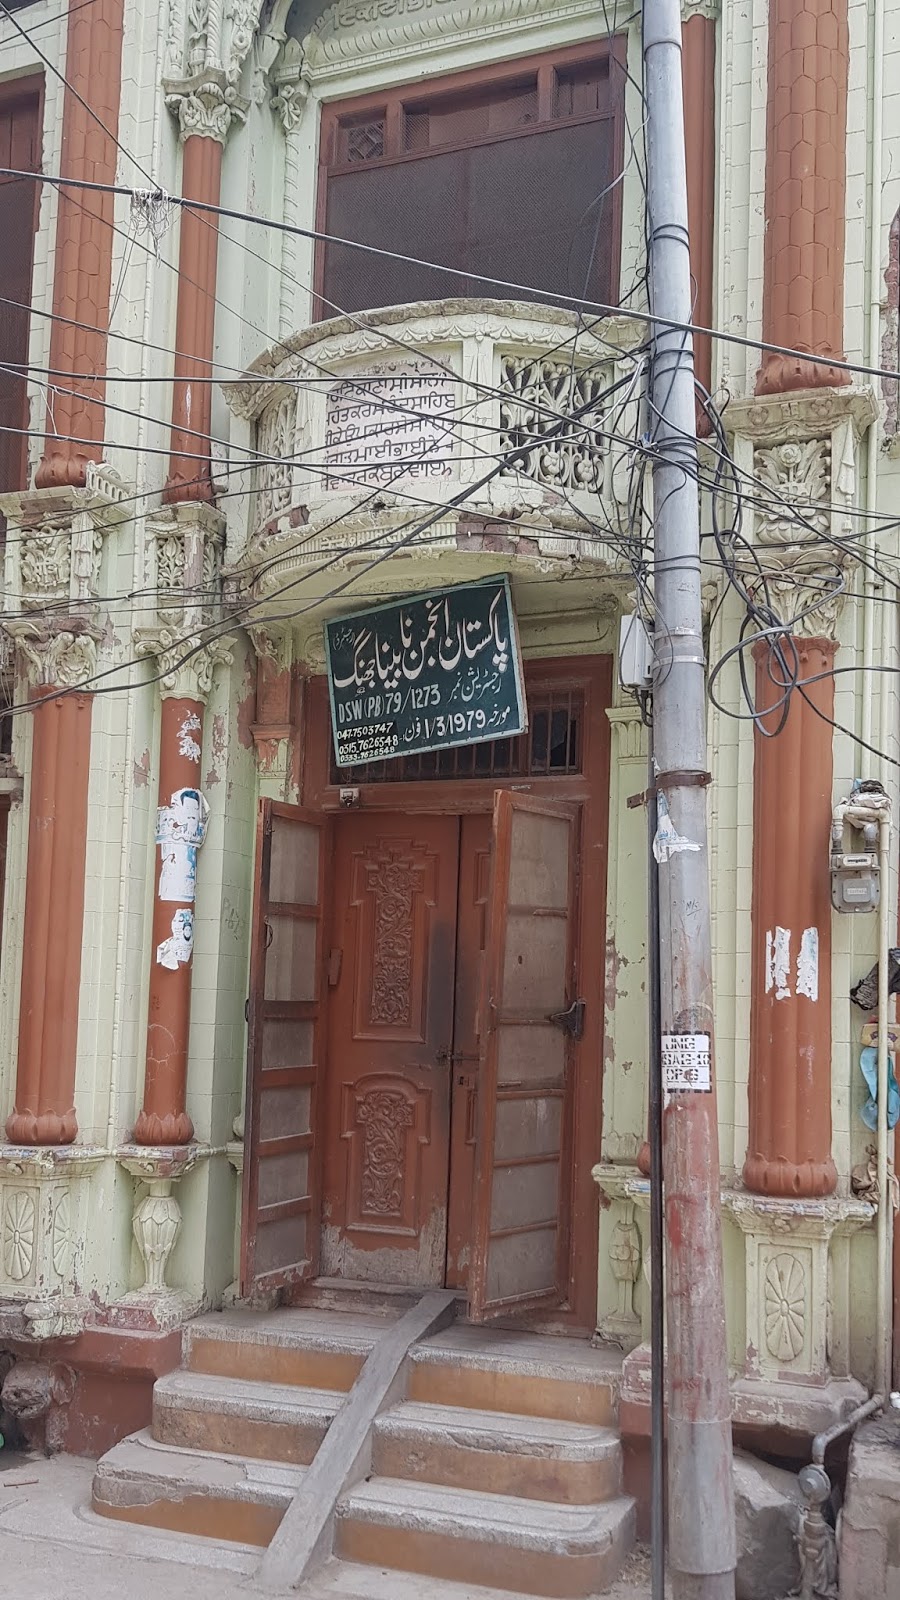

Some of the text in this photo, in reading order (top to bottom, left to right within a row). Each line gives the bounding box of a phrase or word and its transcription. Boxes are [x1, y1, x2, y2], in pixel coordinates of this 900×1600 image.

[333, 628, 375, 689] جھنگ
[402, 598, 448, 680] انجمن
[439, 588, 508, 671] پاکستان
[447, 671, 462, 704] نمبر
